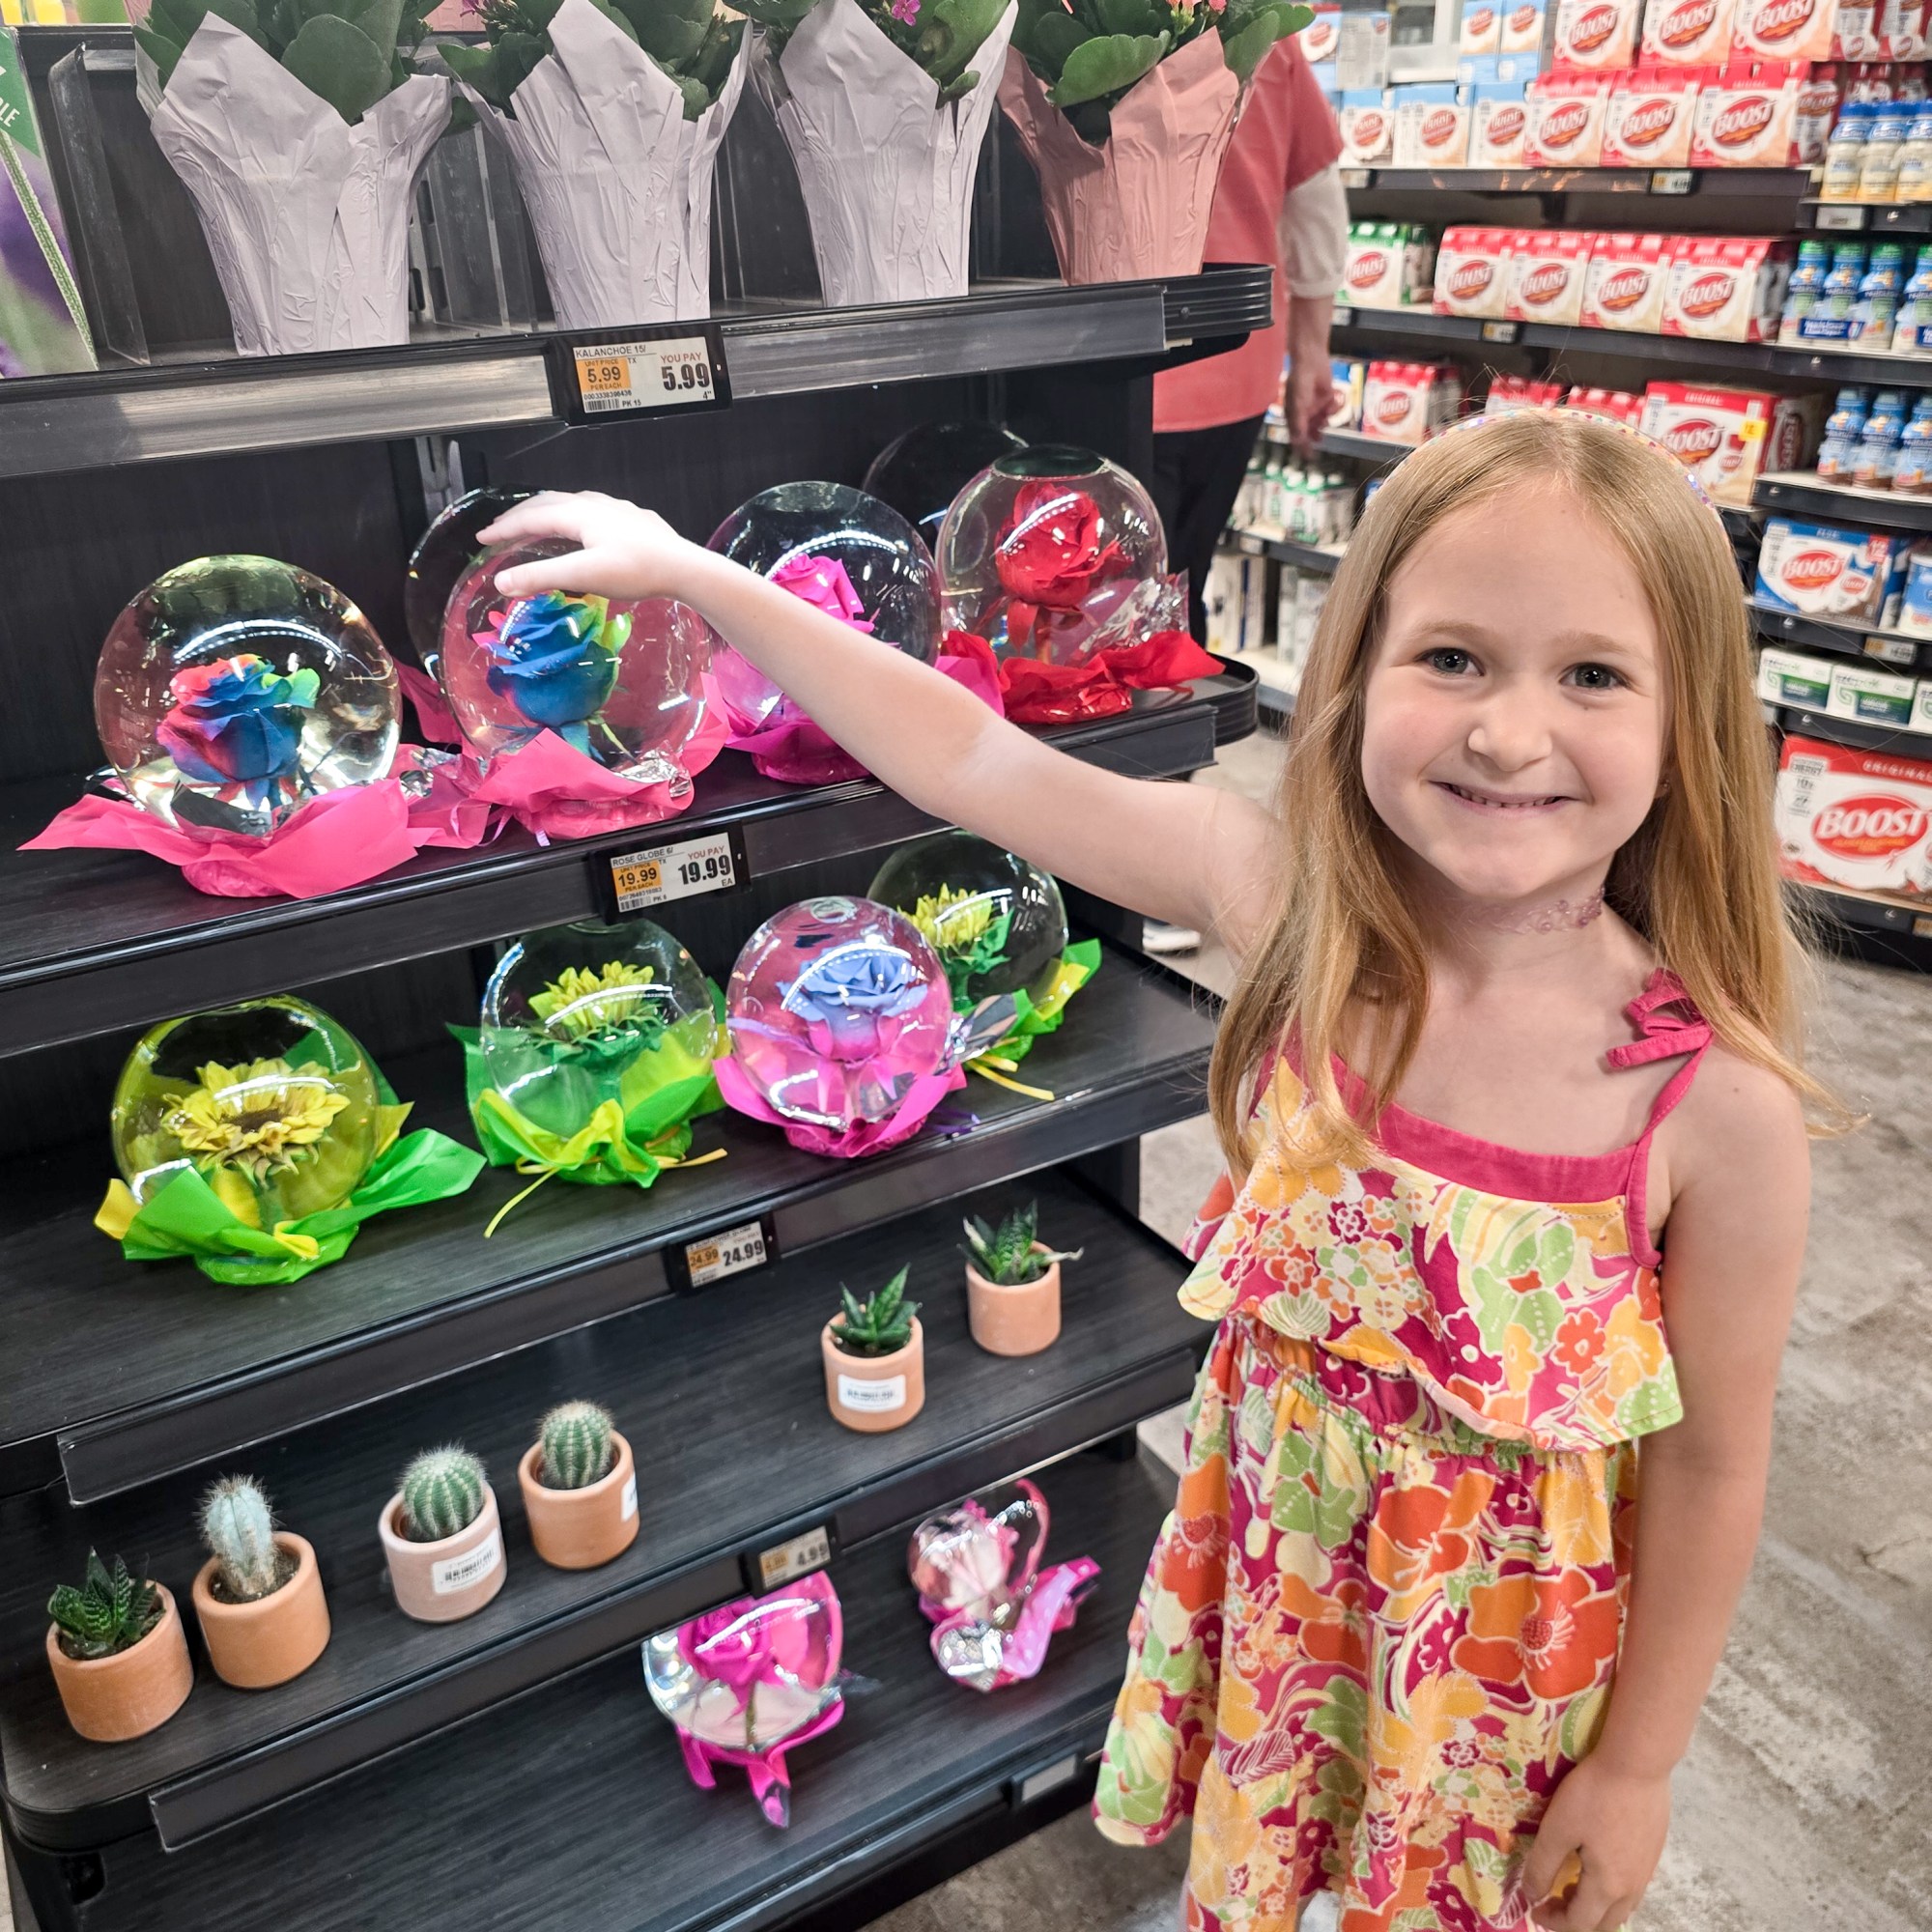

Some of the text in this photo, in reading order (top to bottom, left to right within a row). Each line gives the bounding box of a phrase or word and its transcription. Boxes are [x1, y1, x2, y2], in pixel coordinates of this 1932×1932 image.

[1571, 9, 1620, 45] BOOST
[1661, 1, 1719, 41] BOOST
[1754, 0, 1816, 36] BOOST
[1541, 105, 1592, 141] BOOST
[1623, 102, 1677, 138] BOOST
[1714, 100, 1777, 137] BOOST
[1449, 264, 1496, 287] BOOST
[1522, 267, 1573, 292] BOOST
[1601, 272, 1653, 300] BOOST
[1681, 277, 1738, 307] BOOST
[576, 345, 646, 358] KALANCHOE 15/
[661, 352, 702, 364] YOU PAY
[587, 366, 621, 384] 5.99
[661, 363, 710, 391] 5.99
[1684, 392, 1723, 406] ORIGINAL
[1662, 426, 1726, 453] BOOST
[1786, 556, 1846, 578] BOOST
[1815, 808, 1932, 839] BOOST
[612, 856, 637, 867] ROSE
[638, 849, 666, 863] GLOBE
[688, 845, 724, 861] YOU PAY
[618, 867, 657, 887] 19.99
[678, 855, 731, 885] 19.99
[722, 878, 733, 887] EA
[723, 1239, 764, 1267] 24.99
